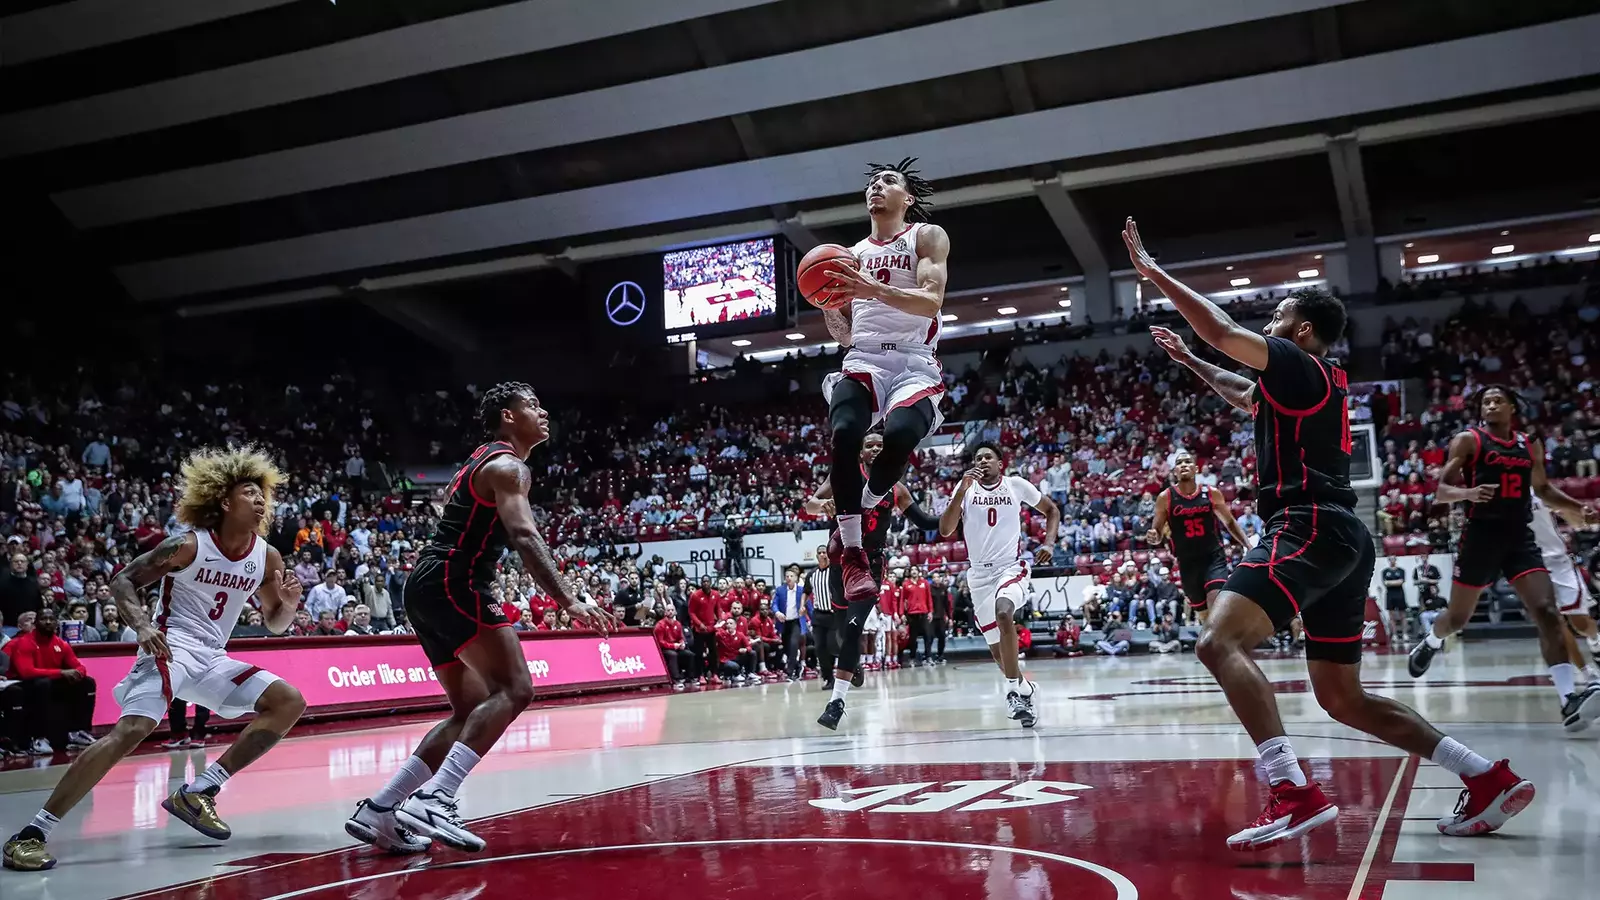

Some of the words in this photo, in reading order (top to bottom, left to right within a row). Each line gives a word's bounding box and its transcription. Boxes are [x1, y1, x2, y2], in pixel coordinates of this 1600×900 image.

[1501, 473, 1522, 498] 12
[972, 496, 1012, 506] ALABAMA
[987, 507, 997, 527] 0
[1184, 518, 1205, 538] 35
[194, 567, 256, 592] ALABAMA
[208, 591, 229, 621] 3
[327, 665, 376, 688] Order
[377, 663, 406, 685] like
[407, 666, 427, 682] an
[527, 659, 550, 678] app
